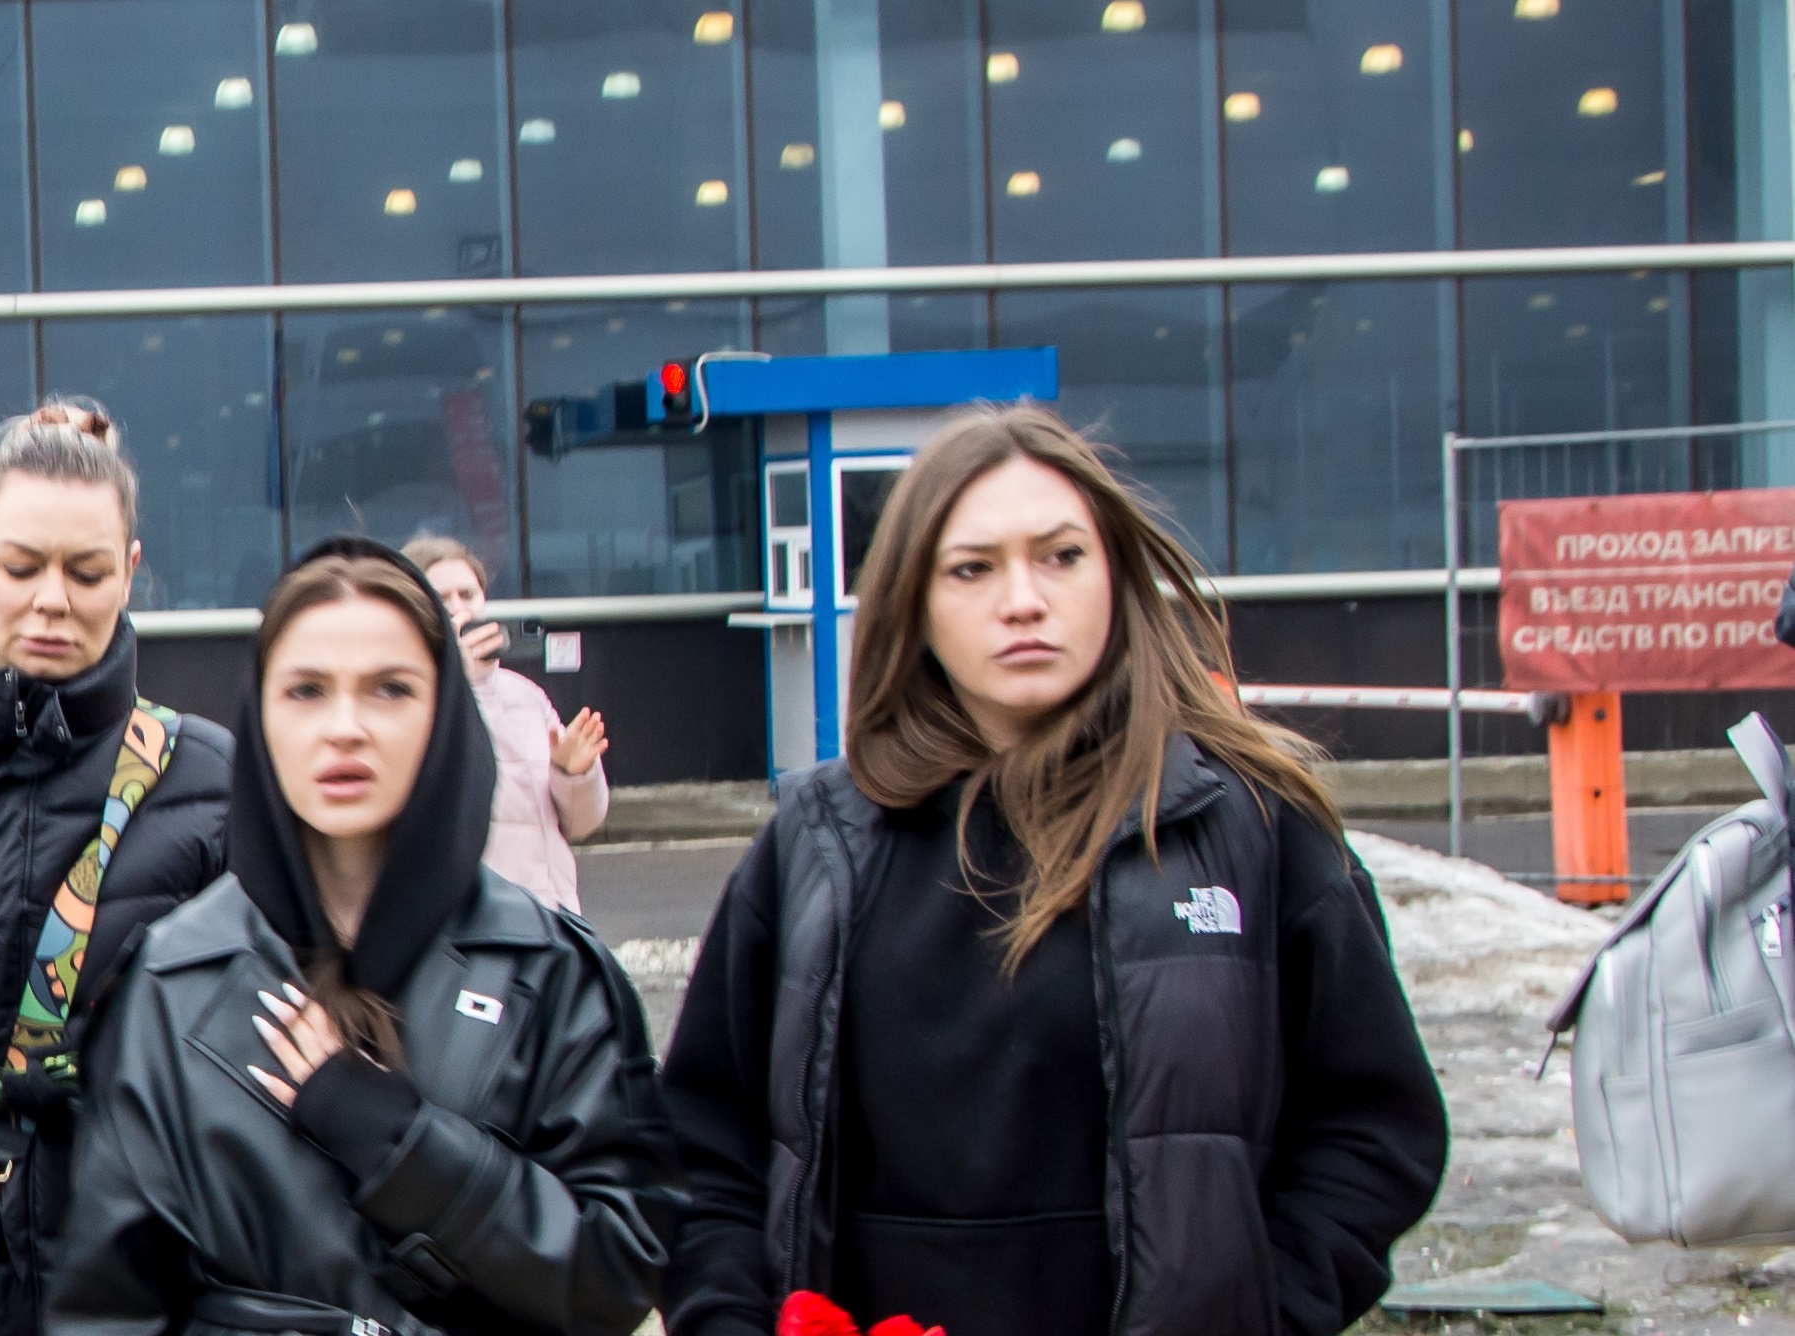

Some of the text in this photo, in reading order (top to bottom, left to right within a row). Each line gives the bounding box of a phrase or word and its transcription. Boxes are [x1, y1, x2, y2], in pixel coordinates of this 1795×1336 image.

[1557, 526, 1795, 561] ПРОХОД ЗАПРЕ
[1530, 585, 1629, 614] ВЪЕЗД
[1513, 624, 1653, 655] СРЕДСТВ
[1659, 623, 1709, 650] ПО
